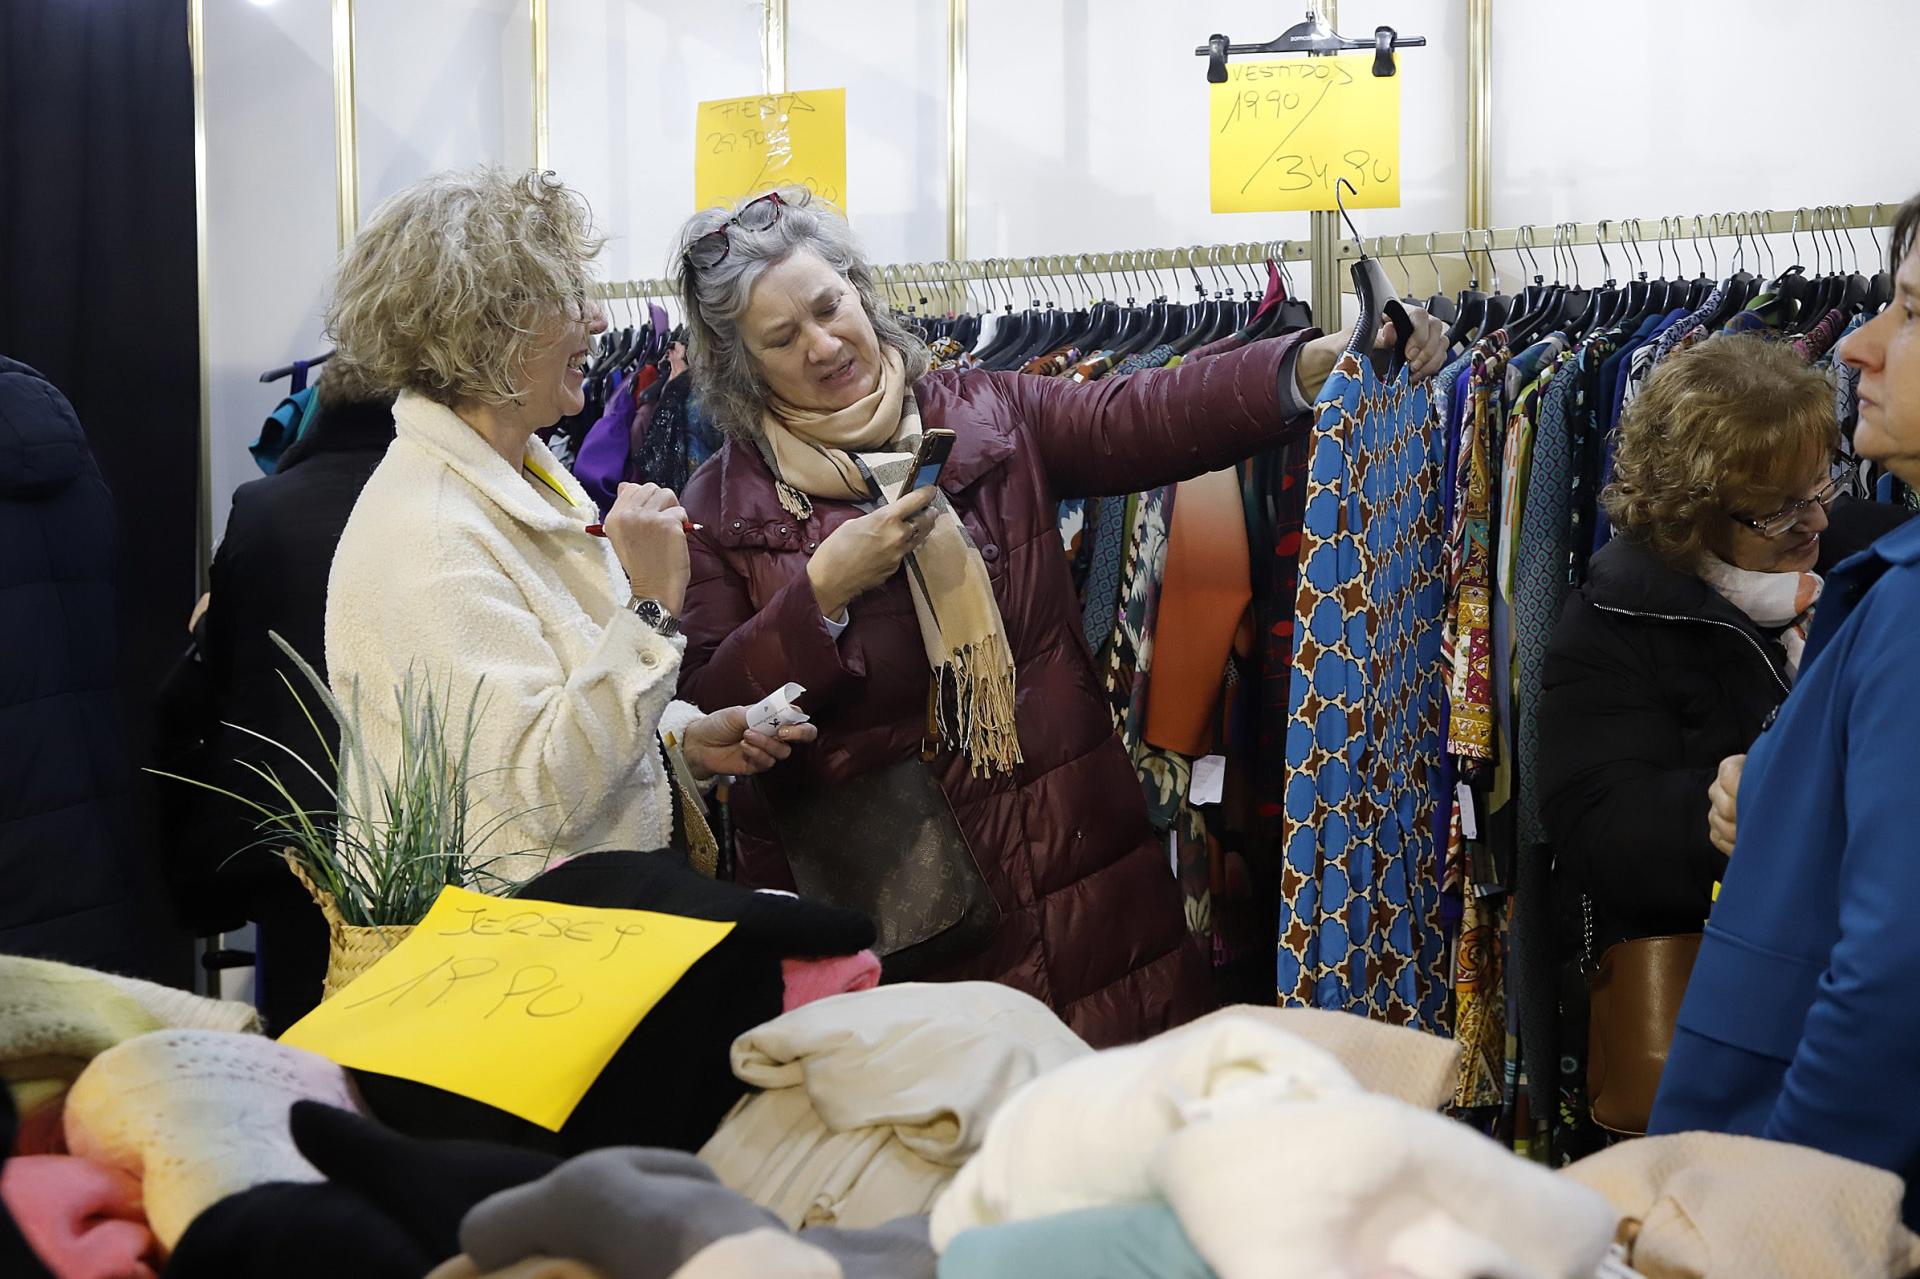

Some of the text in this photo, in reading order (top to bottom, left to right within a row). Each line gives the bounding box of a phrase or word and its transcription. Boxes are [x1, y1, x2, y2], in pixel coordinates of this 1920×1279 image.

[1232, 60, 1353, 85] VESTIDOS
[710, 92, 816, 120] FIESTA
[438, 906, 645, 962] JERSEY
